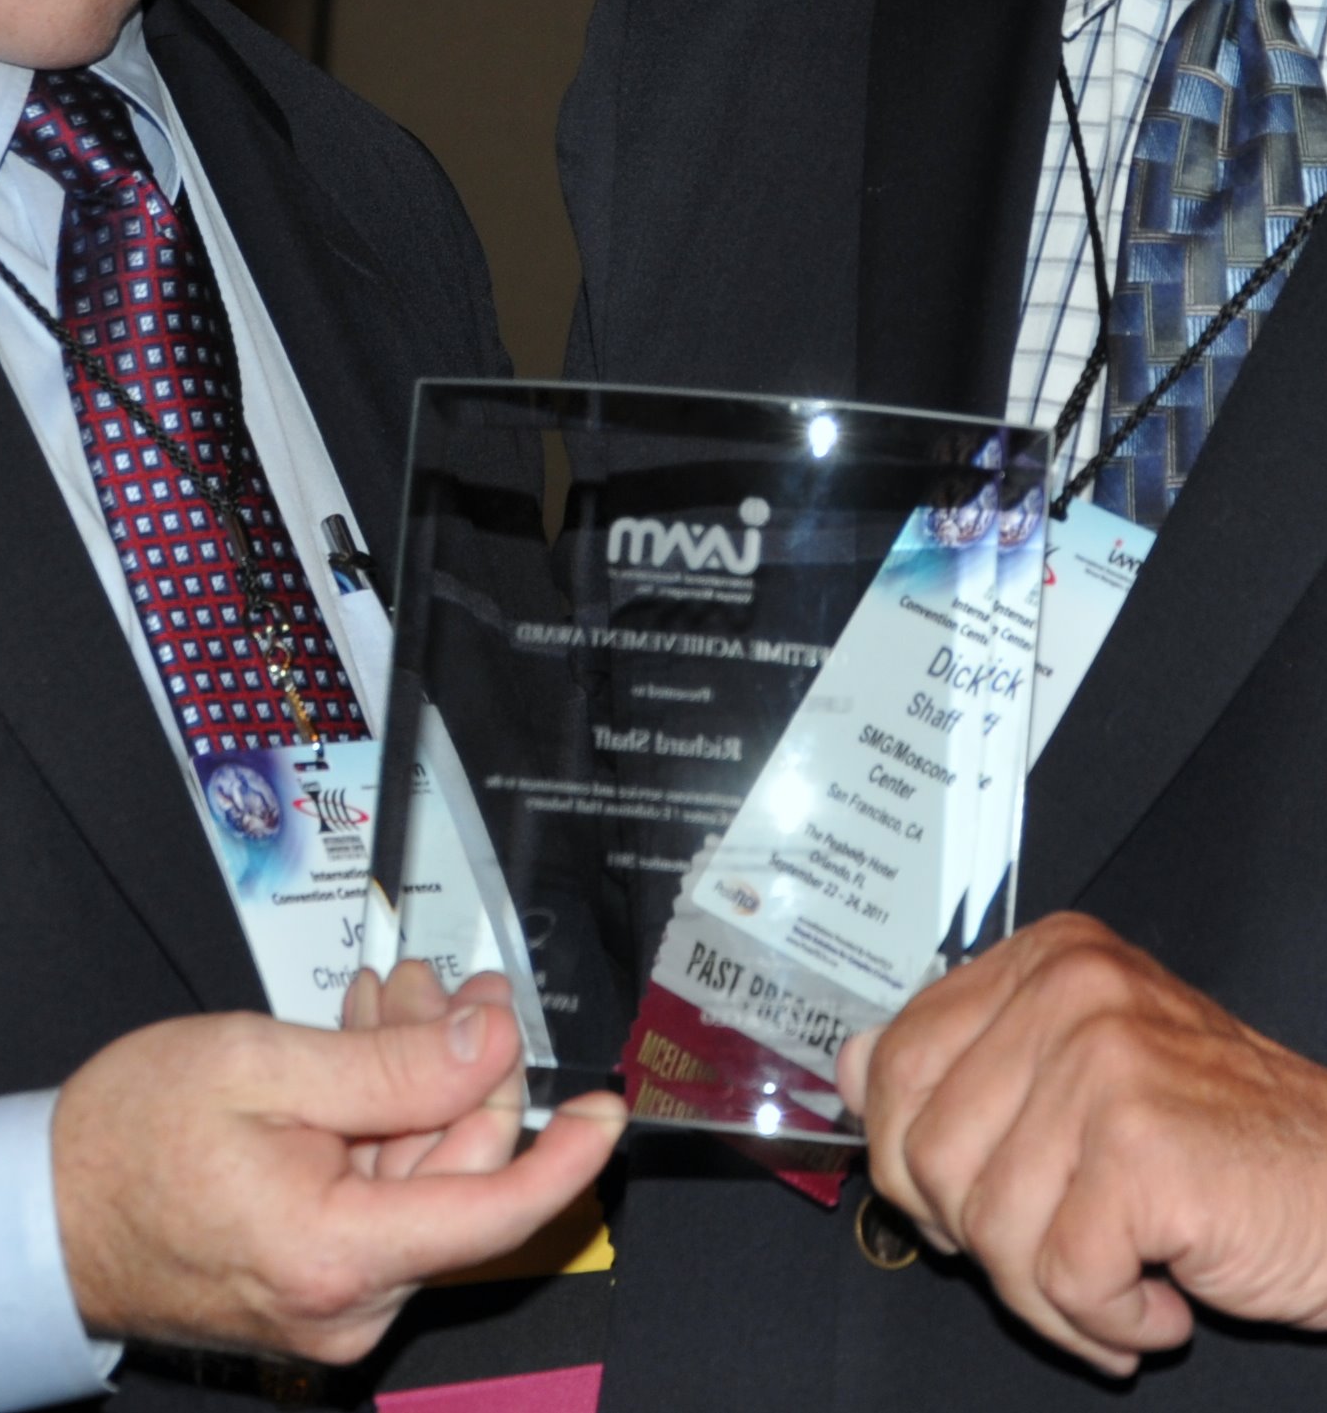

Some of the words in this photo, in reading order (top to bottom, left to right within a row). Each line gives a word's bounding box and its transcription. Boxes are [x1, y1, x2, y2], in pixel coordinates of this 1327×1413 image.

[899, 594, 958, 630] Convention
[868, 763, 917, 801] Center
[826, 781, 849, 804] San
[905, 822, 925, 843] CA
[823, 833, 867, 867] Peabody
[867, 857, 900, 881] Hotel
[272, 888, 335, 906] Convention
[768, 849, 824, 889] September
[862, 901, 890, 925] 2011
[684, 940, 745, 997] PAST
